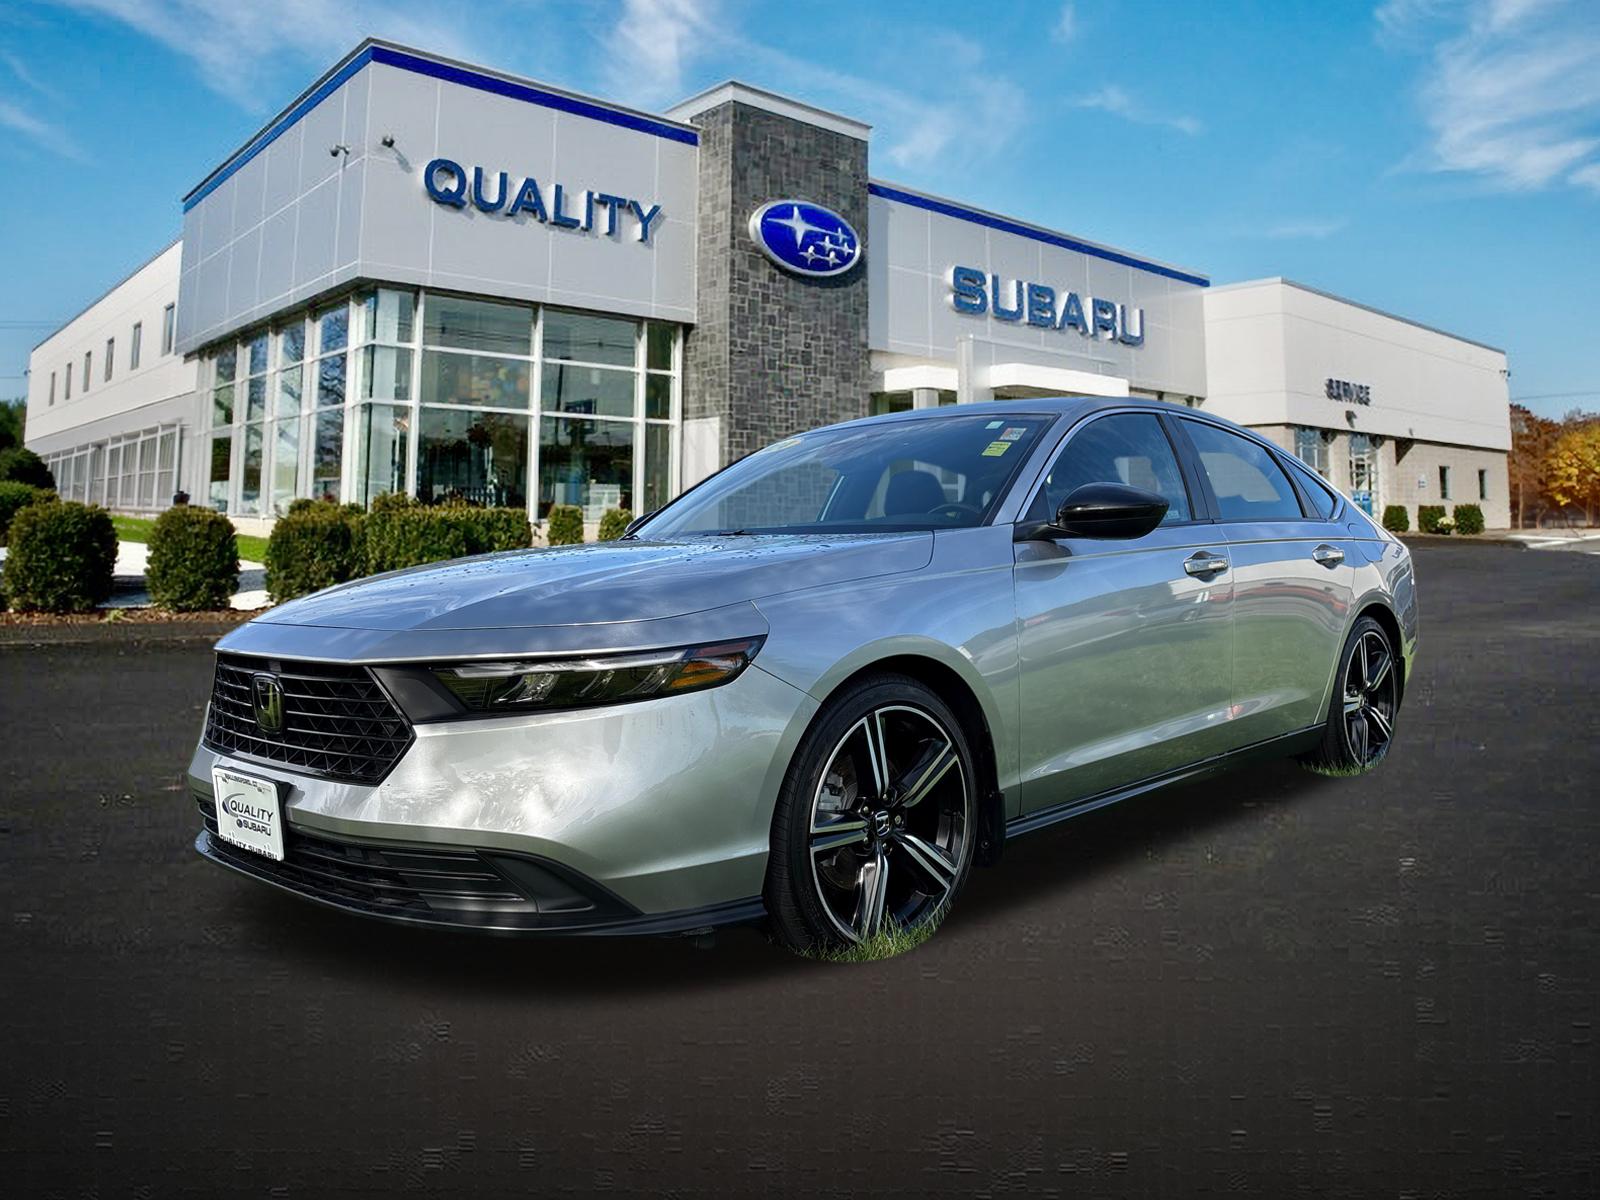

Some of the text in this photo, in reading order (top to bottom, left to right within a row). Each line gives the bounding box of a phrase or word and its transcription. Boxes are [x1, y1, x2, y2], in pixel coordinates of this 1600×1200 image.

[424, 158, 661, 243] QUALITY
[951, 265, 1145, 346] SUBARU
[1324, 378, 1371, 406] SERVICE
[230, 800, 274, 822] QUALITY
[242, 821, 271, 836] SUBARU
